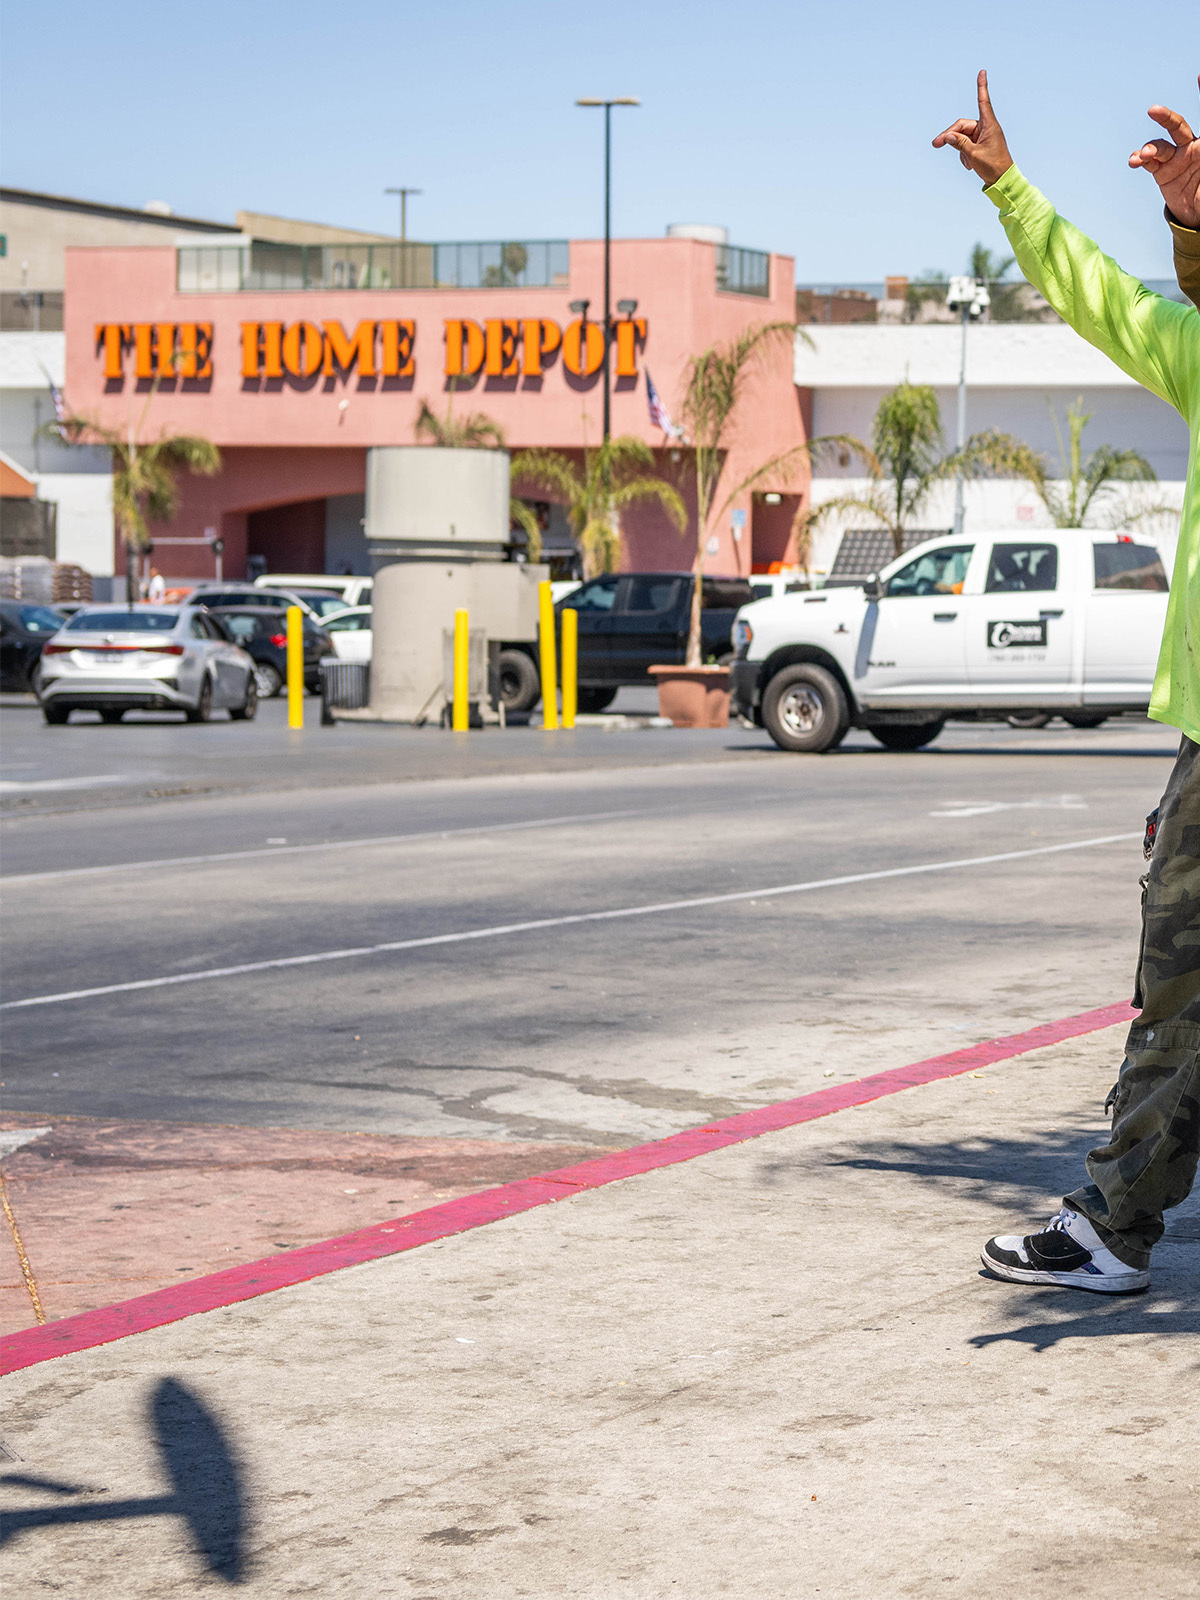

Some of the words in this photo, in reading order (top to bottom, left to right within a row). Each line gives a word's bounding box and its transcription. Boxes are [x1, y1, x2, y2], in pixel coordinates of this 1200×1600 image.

[94, 322, 214, 379] THE
[239, 320, 416, 378] HOME
[443, 317, 648, 377] DEPOT
